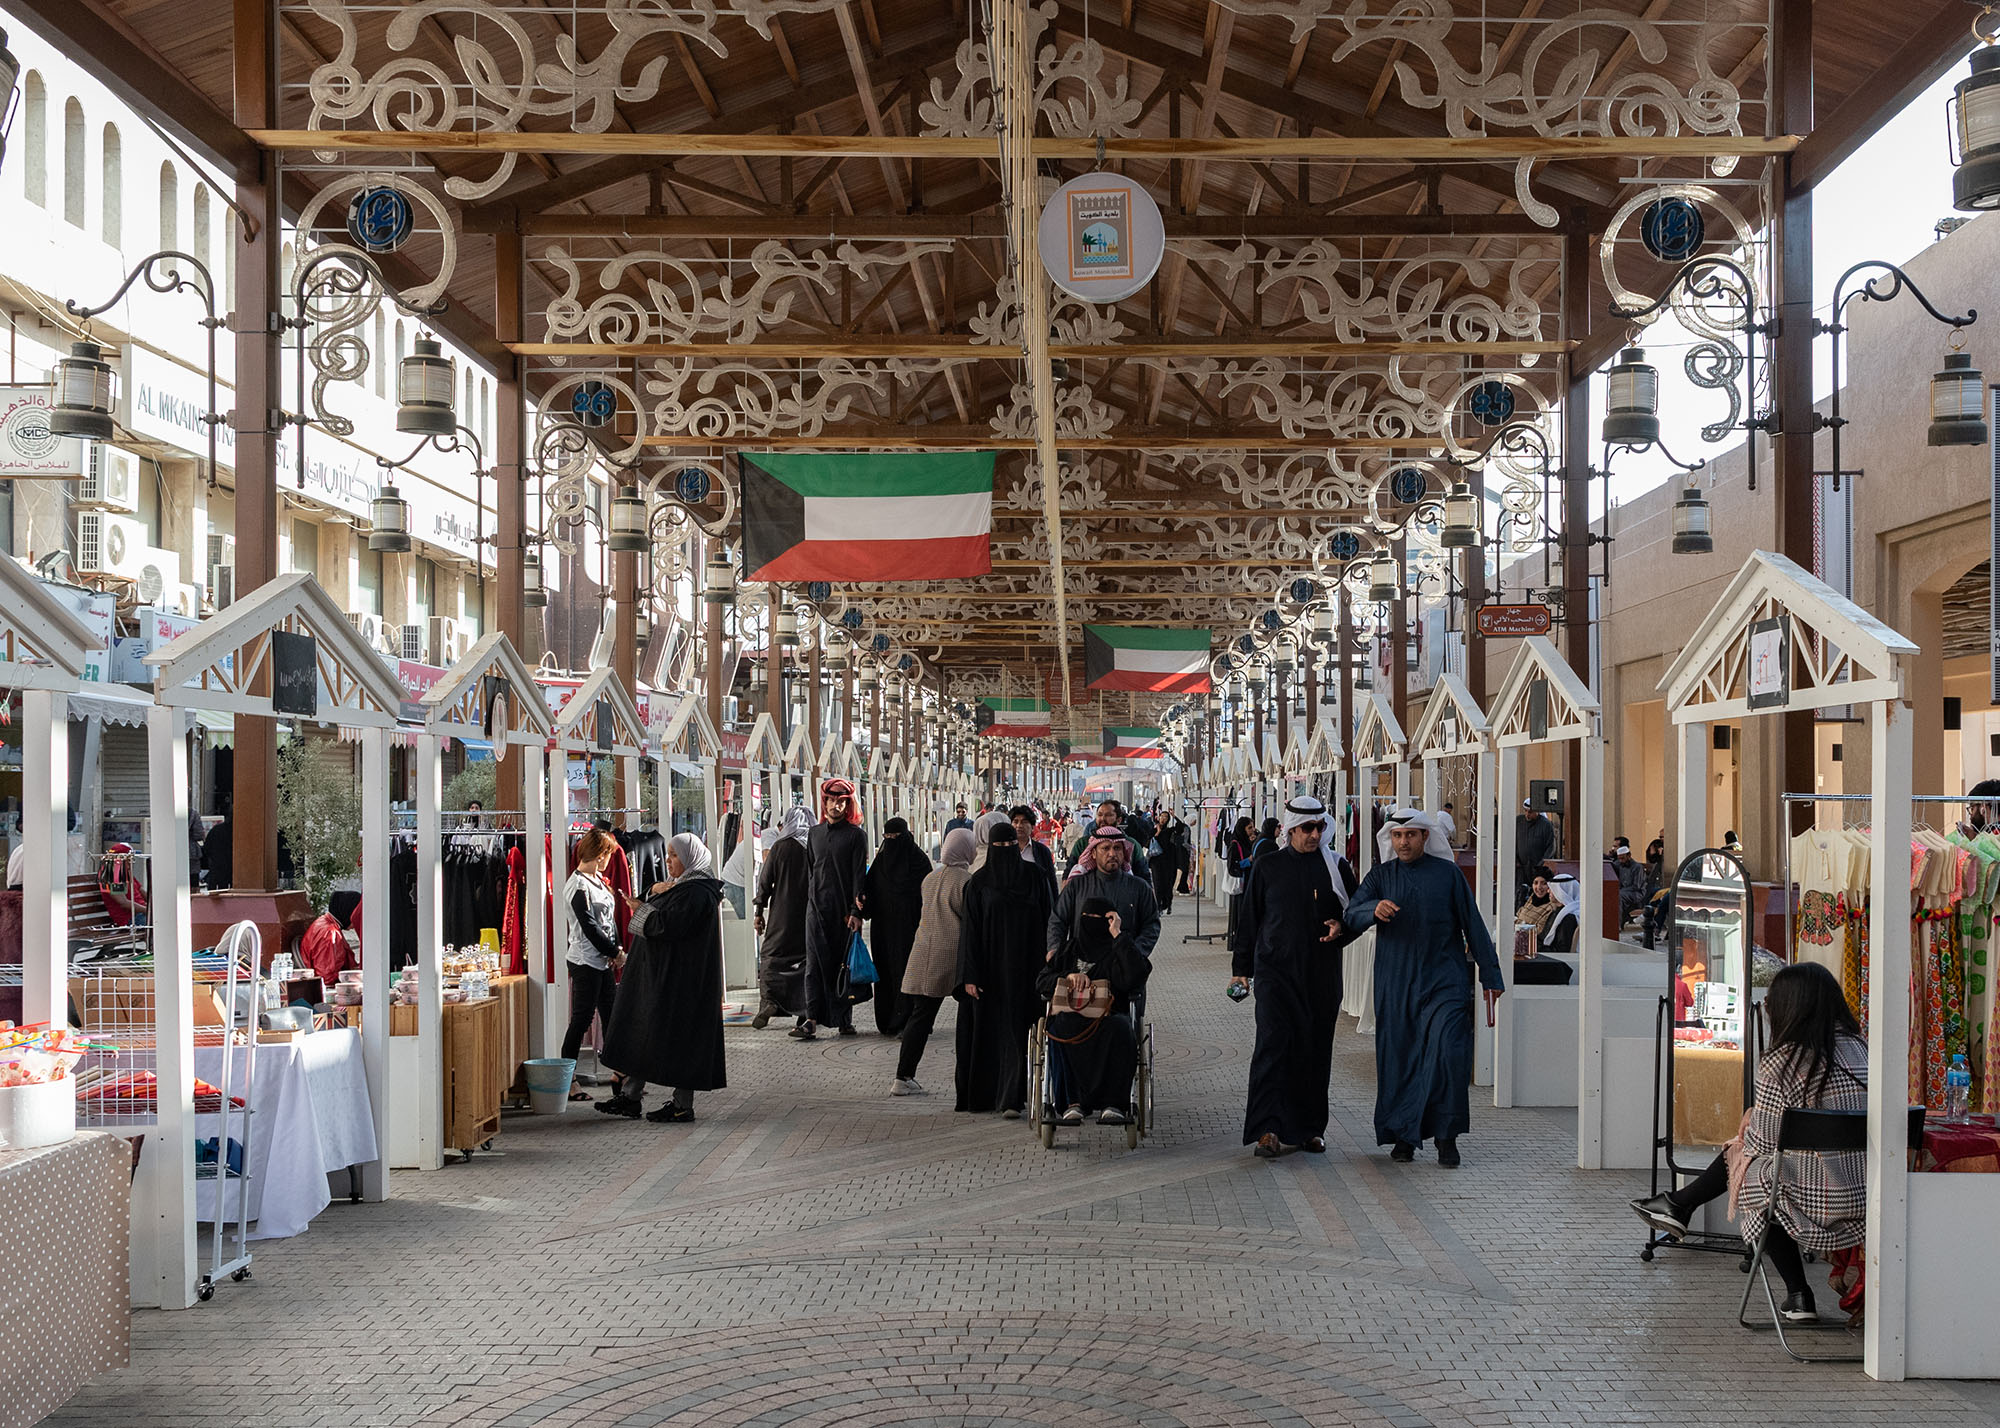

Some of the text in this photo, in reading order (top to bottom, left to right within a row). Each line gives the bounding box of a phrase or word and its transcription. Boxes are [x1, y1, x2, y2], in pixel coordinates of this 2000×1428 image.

[1080, 210, 1119, 219] بلدية الكويت
[1094, 267, 1129, 276] Municipality
[137, 383, 156, 416] AL
[574, 388, 612, 417] 26
[1474, 390, 1512, 418] 25
[34, 459, 70, 470] للملابس
[1511, 616, 1534, 624] السحب
